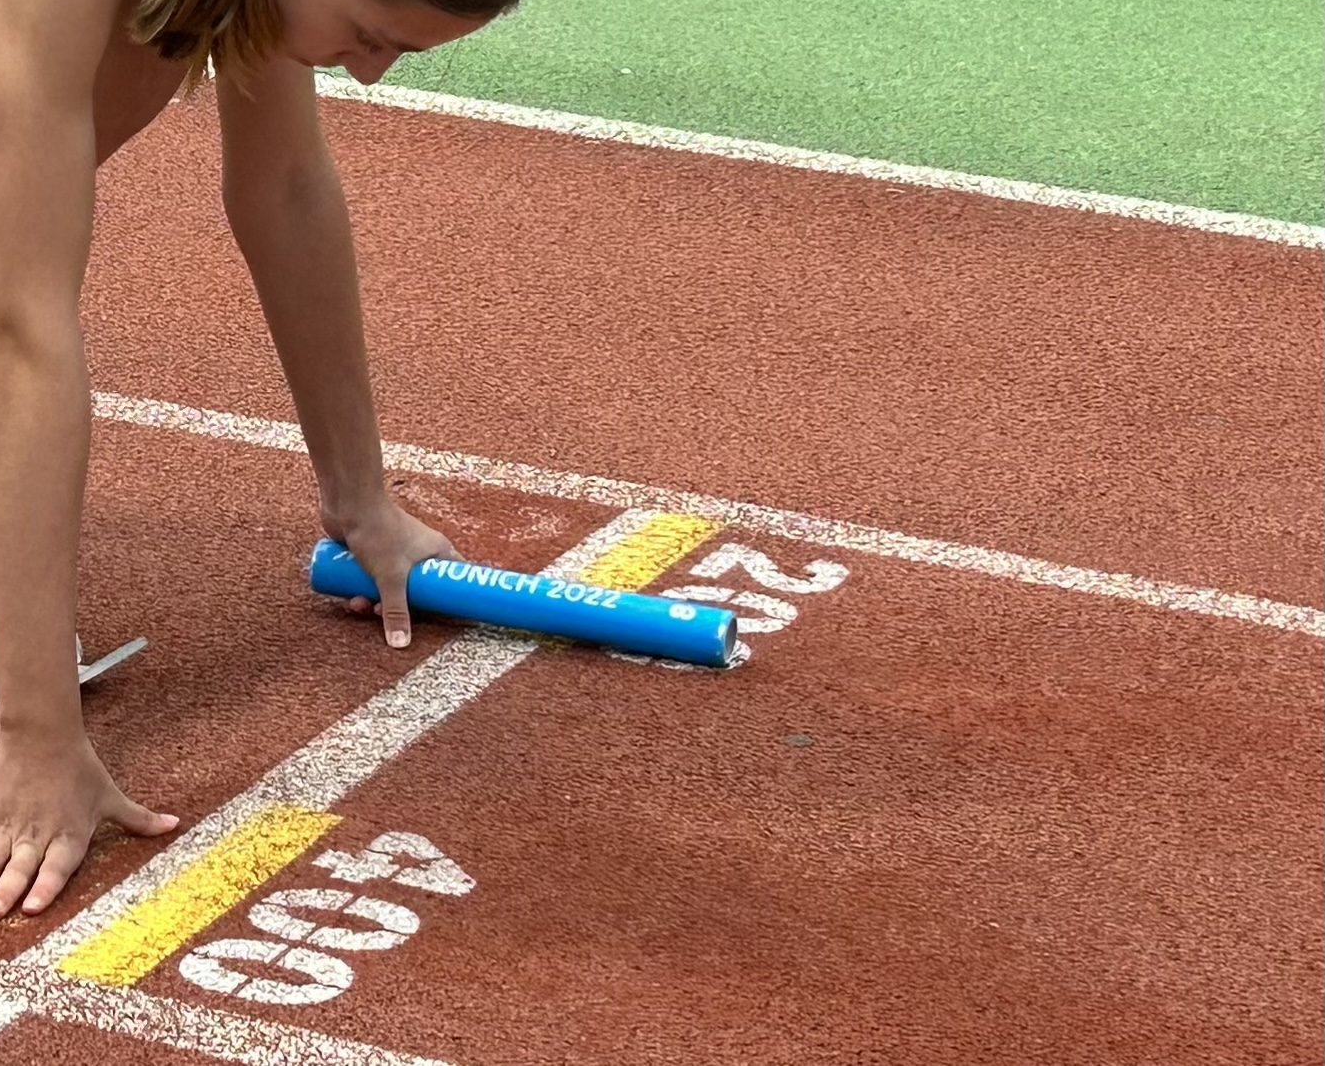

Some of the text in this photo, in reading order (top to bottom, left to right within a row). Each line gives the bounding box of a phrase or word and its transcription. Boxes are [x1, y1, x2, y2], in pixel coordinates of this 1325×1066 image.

[421, 558, 621, 609] MUNICH 2022
[604, 542, 850, 670] 20
[178, 831, 477, 1005] 400
